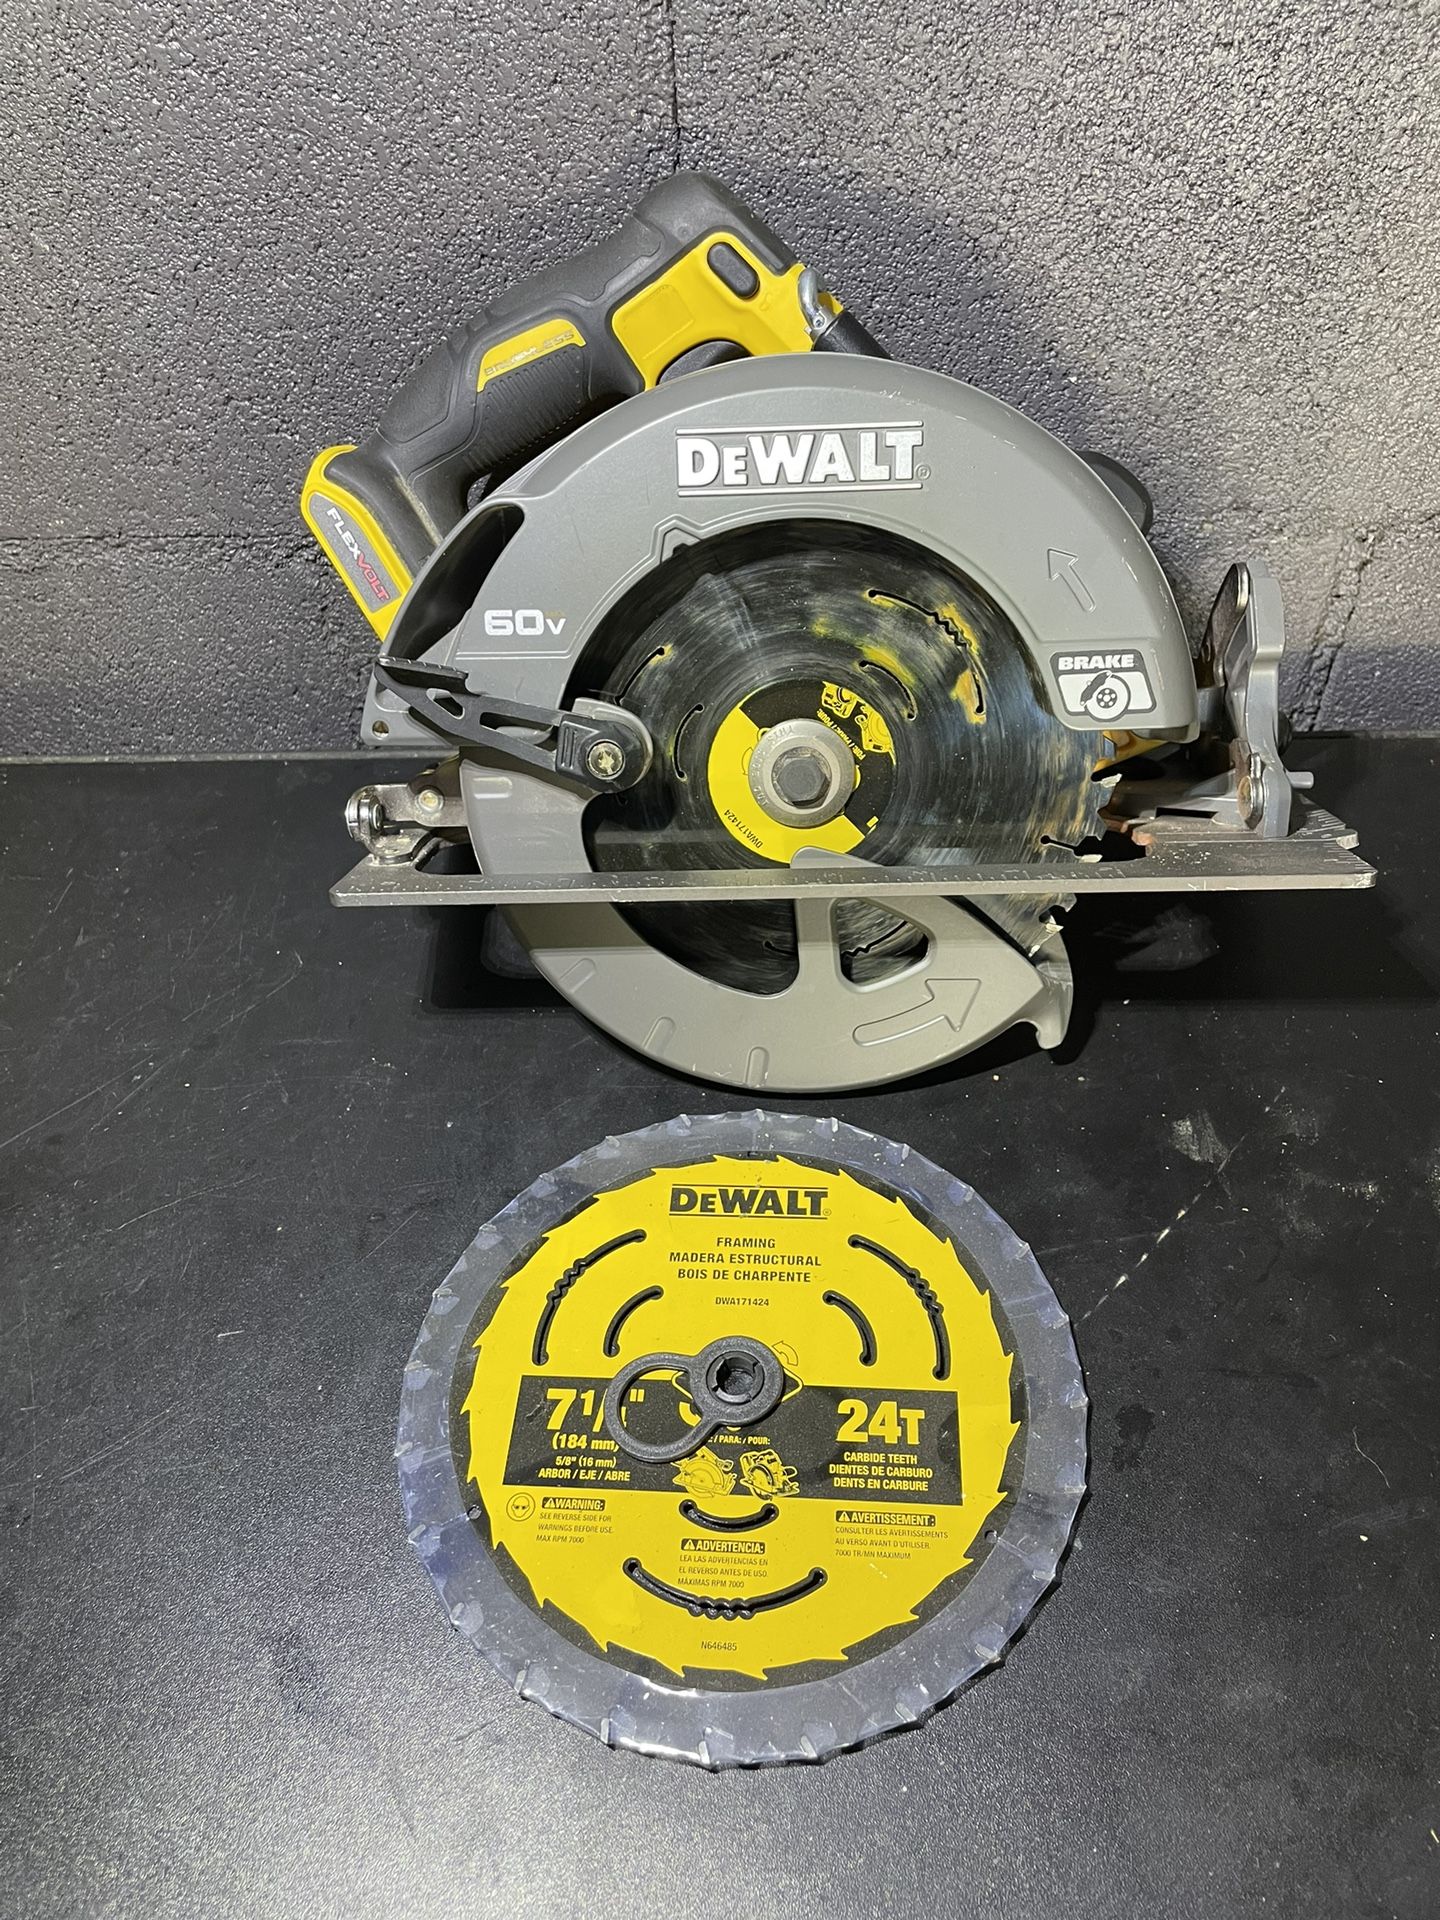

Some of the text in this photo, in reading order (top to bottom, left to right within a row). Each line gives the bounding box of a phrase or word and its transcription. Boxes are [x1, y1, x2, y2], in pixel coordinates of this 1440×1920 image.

[326, 507, 391, 601] FLEXVOLT
[1058, 654, 1135, 670] BRAKE
[724, 809, 764, 849] DWA171424
[716, 1237, 776, 1248] FRAMING
[669, 1252, 822, 1266] MADERA ESTRUCTURAL
[677, 1268, 811, 1283] BOIS DE CHARPENTE
[715, 1296, 769, 1307] DWA171424
[836, 1398, 925, 1445] 24T
[551, 1431, 587, 1450] (184
[719, 1434, 742, 1444] PARA:
[748, 1436, 771, 1445] POUR:
[555, 1455, 617, 1468] 5/8" (16 mm)
[843, 1452, 918, 1464] CARBIDE TEETH
[538, 1468, 571, 1479] ARBOR
[579, 1469, 597, 1480] EJE
[604, 1470, 631, 1481] ABRE
[829, 1464, 933, 1478] DIENTES DE CARBURO
[833, 1477, 929, 1491] DENTS EN CARBURE
[555, 1498, 604, 1510] WARNING:
[539, 1512, 612, 1522] SEE REVERSE SIDE FOR
[538, 1524, 572, 1532] WARNINGS
[574, 1525, 598, 1533] BEFORE
[835, 1526, 949, 1539] CONSULTER LES AVERTISSEMENTS
[536, 1534, 585, 1544] MAX RPM 7000
[846, 1538, 868, 1546] VERSO
[869, 1539, 891, 1547] AVANT
[696, 1540, 764, 1554] ADVERTENCIA:
[694, 1555, 706, 1563] LAS
[708, 1556, 758, 1565] ADVERTENCIAS
[759, 1558, 768, 1566] EN
[835, 1549, 852, 1557] 7000
[876, 1551, 911, 1560] MAXIMUM
[679, 1566, 686, 1574] EL
[688, 1566, 719, 1575] REVERSO
[720, 1568, 741, 1576] ANTES
[743, 1569, 751, 1577] DE
[711, 1579, 727, 1587] RPM
[701, 1641, 737, 1651] N646485
